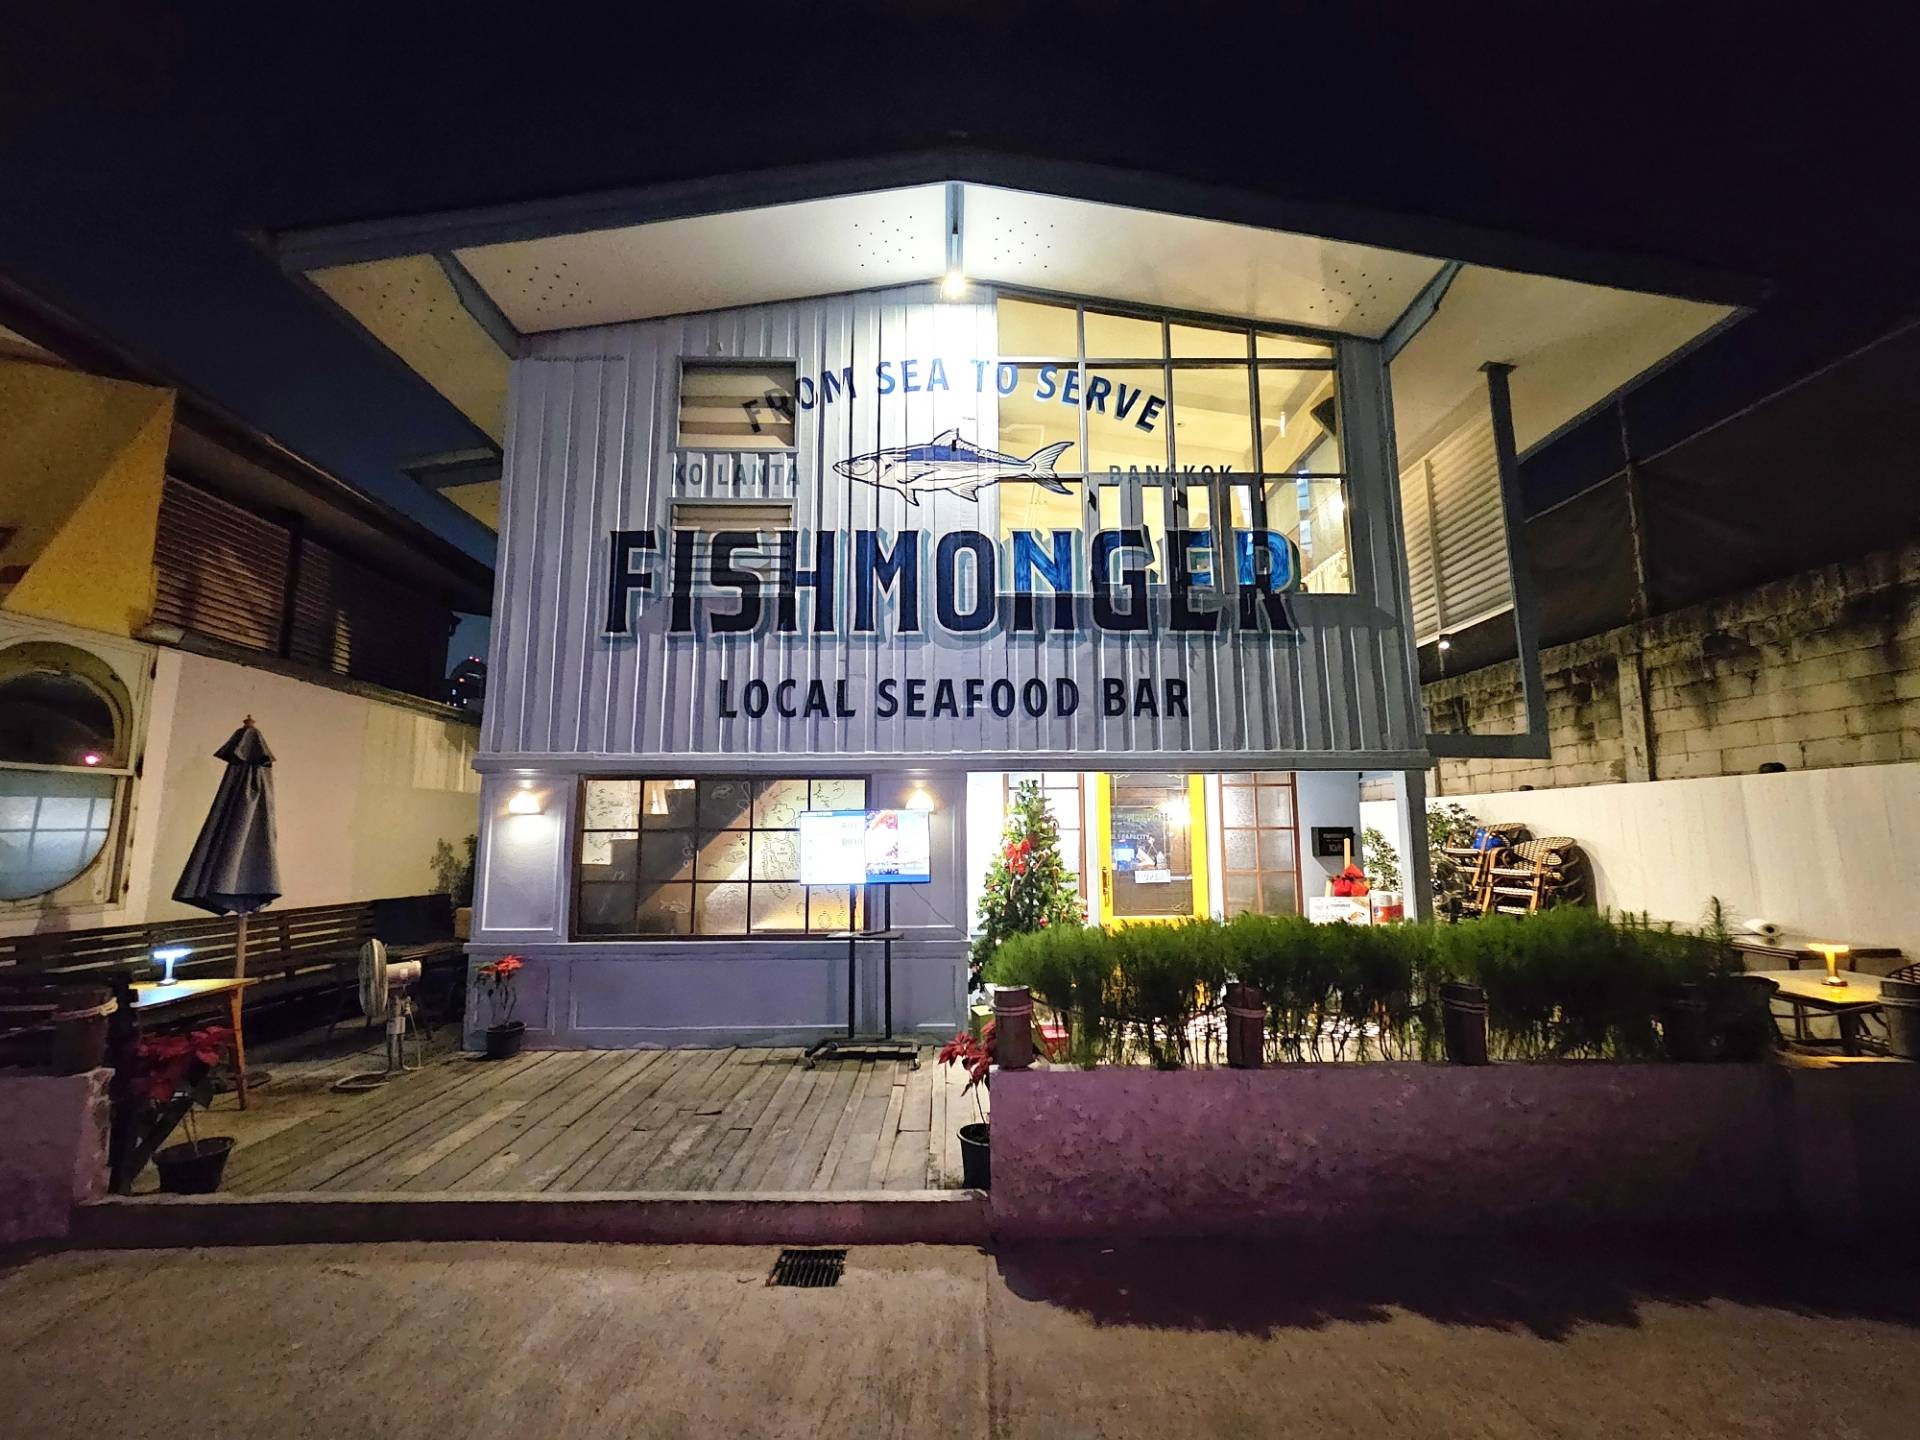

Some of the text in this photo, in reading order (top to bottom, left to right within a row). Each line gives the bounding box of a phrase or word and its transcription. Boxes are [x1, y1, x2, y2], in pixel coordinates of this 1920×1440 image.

[742, 358, 1166, 433] FROM SEA TO SERVE
[672, 463, 801, 486] KO LANTA
[1108, 464, 1233, 484] BANGKOK
[600, 526, 1303, 642] FISHMONGER
[719, 677, 1189, 719] LOCAL SEAFOOD BAR
